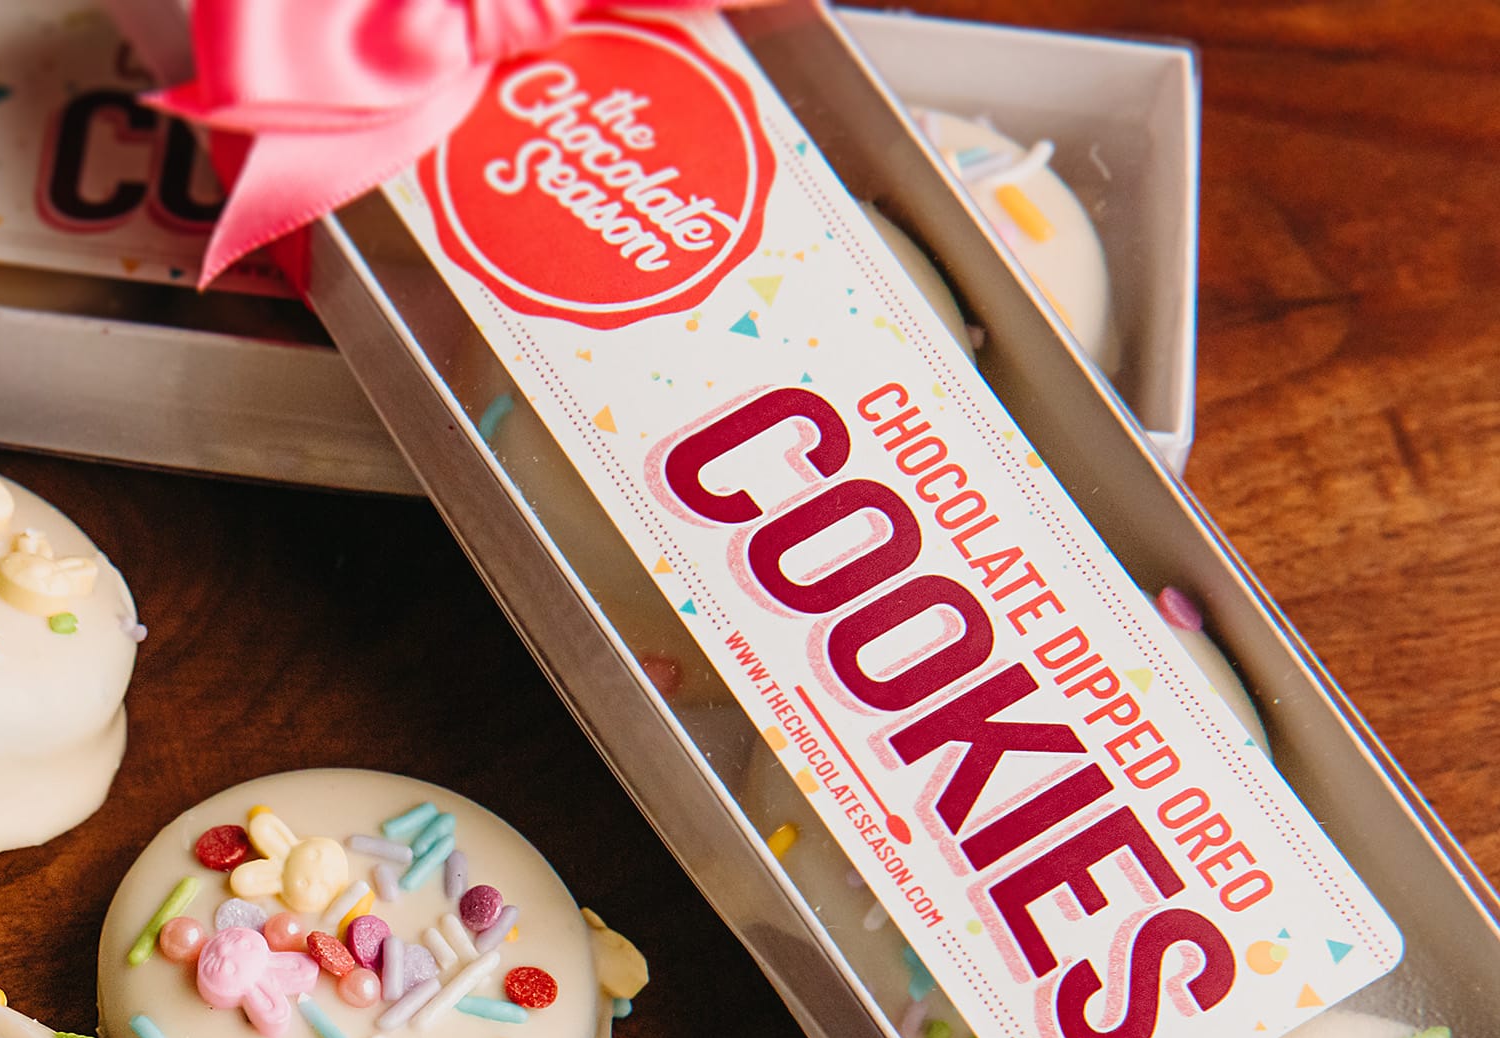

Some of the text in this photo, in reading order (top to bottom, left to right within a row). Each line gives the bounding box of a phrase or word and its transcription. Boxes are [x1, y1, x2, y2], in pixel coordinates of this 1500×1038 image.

[484, 138, 671, 272] Season
[499, 61, 722, 251] Chocolate
[589, 88, 657, 150] the
[857, 381, 1274, 912] CHOCOLATE DIPPED OREO
[724, 630, 944, 928] WWW.THECHOCOLATESEASON.COM
